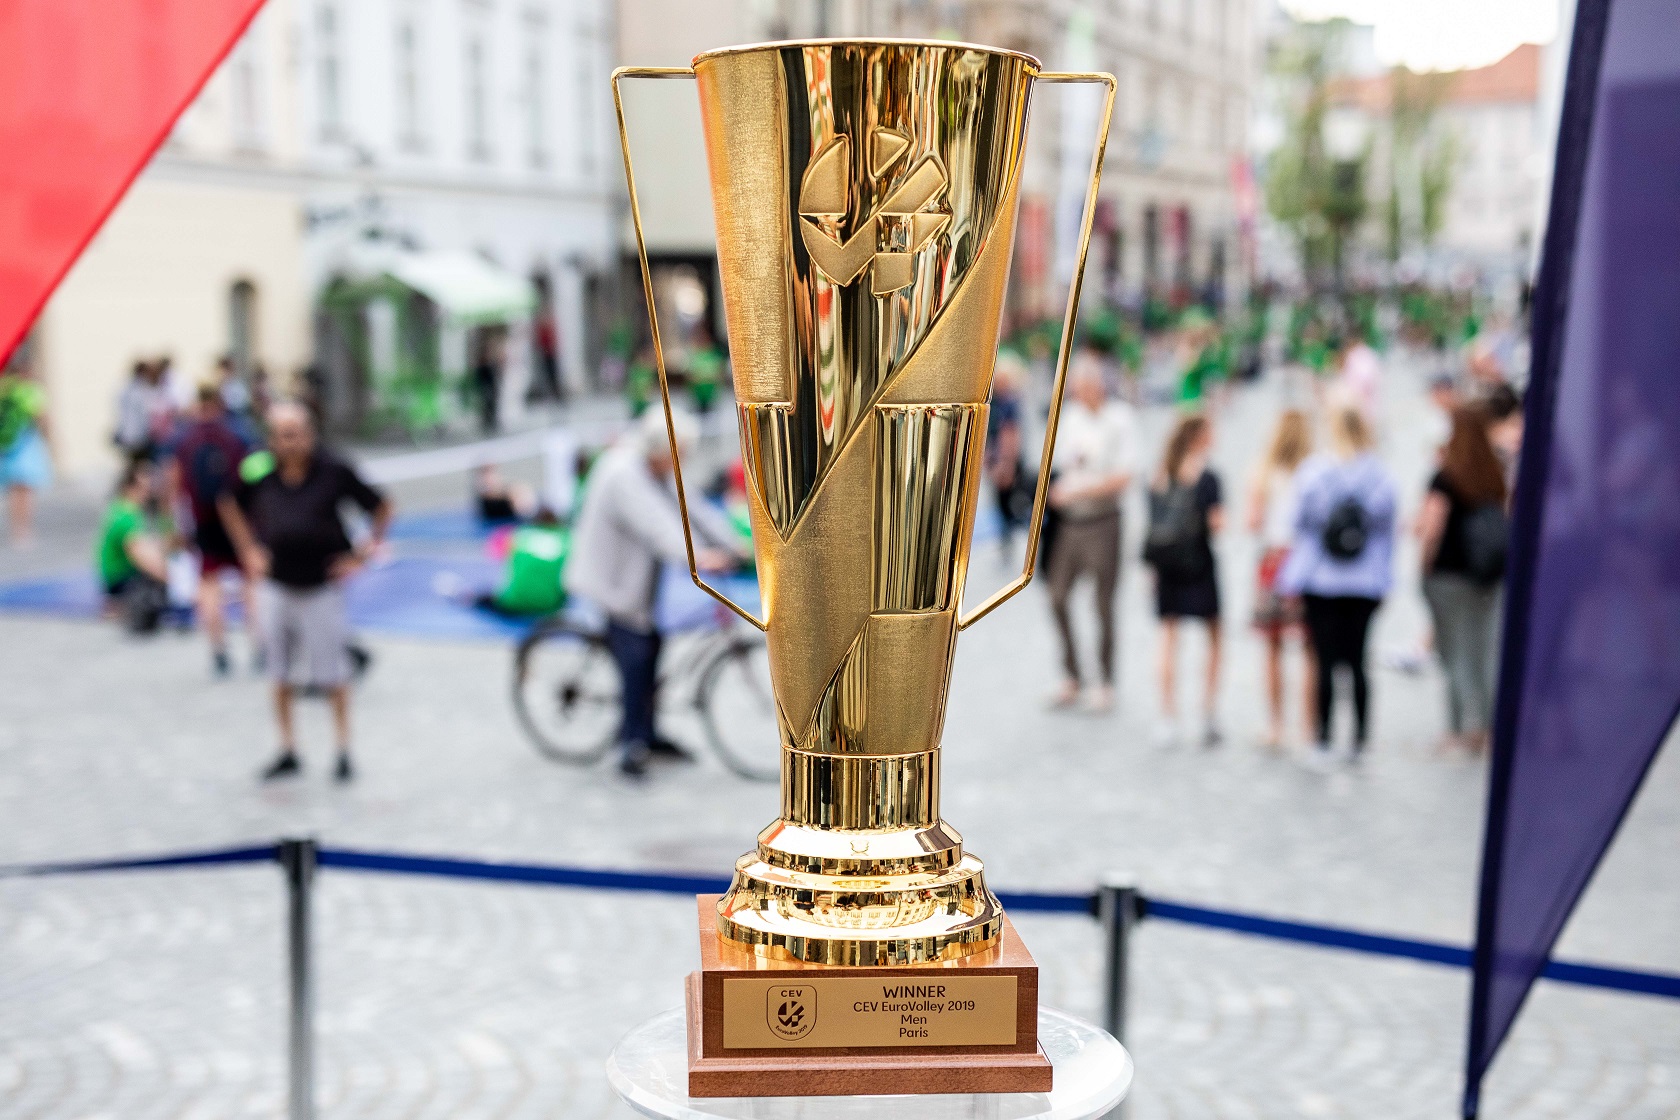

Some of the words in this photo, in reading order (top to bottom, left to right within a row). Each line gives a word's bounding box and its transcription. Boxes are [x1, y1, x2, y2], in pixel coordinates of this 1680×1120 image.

[780, 989, 803, 998] CEV
[883, 985, 946, 998] WINNER
[853, 1001, 878, 1012] CEV
[881, 1000, 944, 1013] EuroVolley
[947, 1000, 975, 1011] 2019
[900, 1014, 927, 1024] Men
[899, 1027, 928, 1038] Paris
